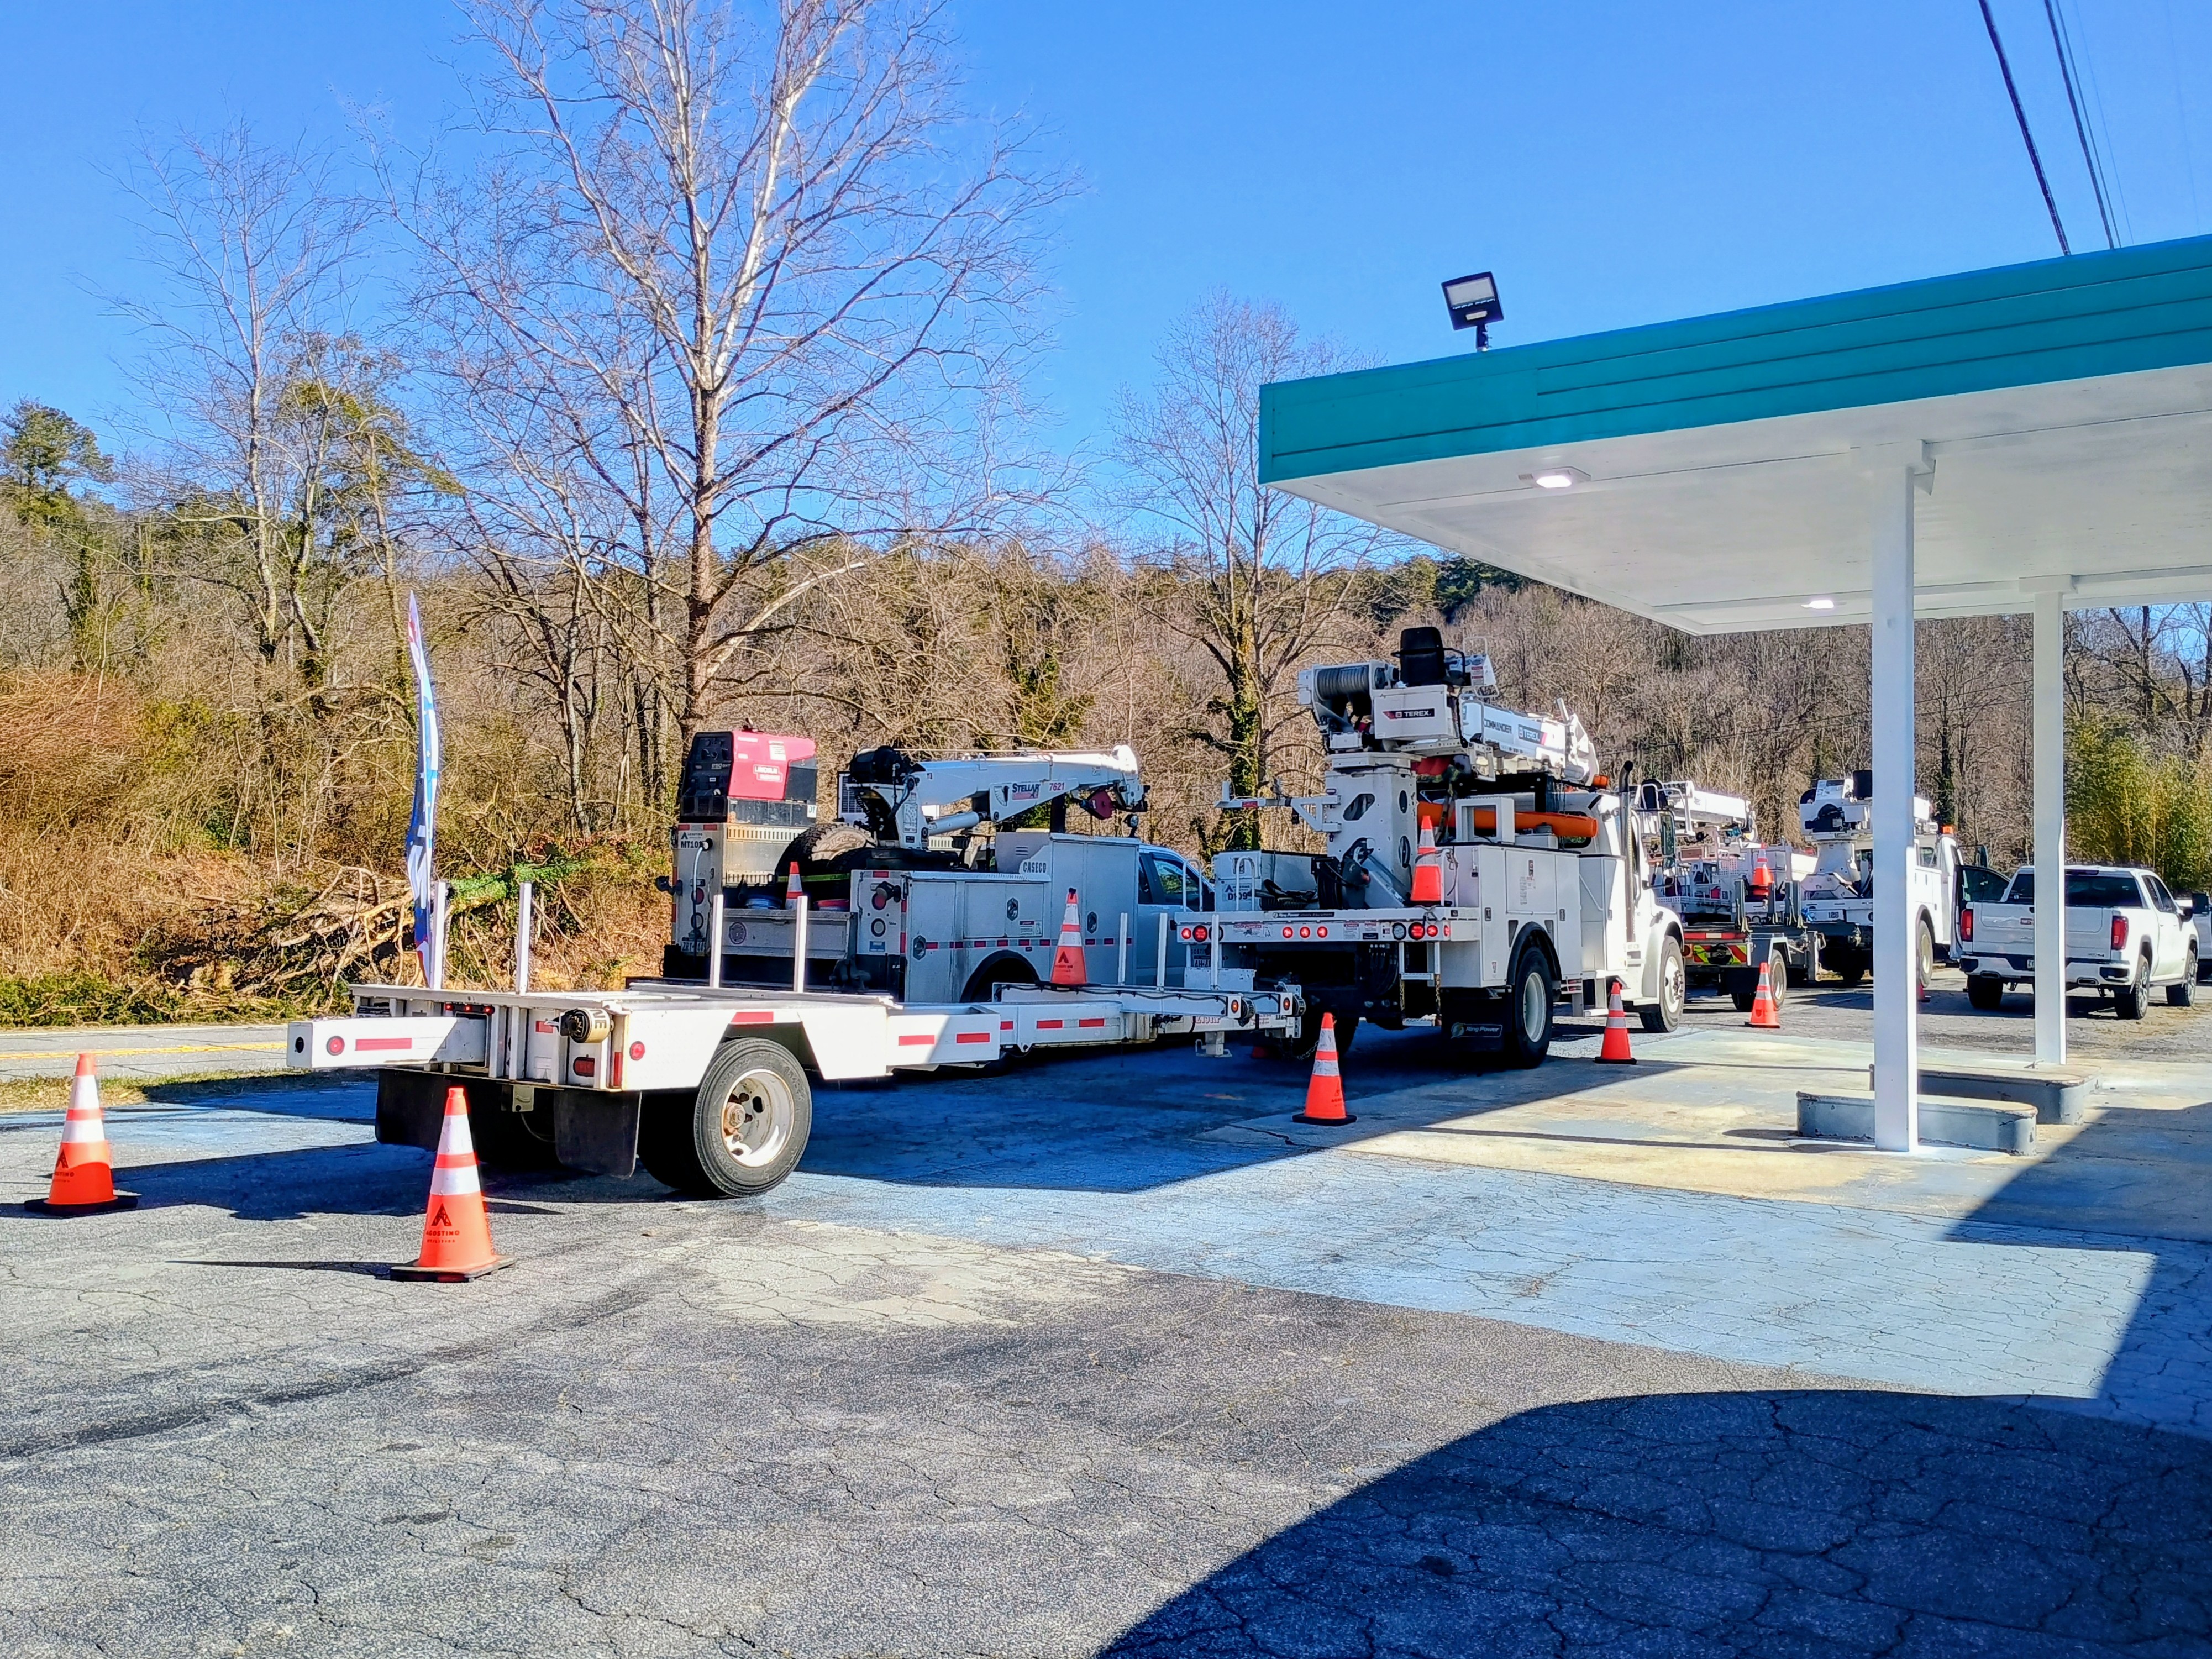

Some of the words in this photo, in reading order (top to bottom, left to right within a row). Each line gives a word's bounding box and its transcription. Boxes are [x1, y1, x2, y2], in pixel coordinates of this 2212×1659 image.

[1012, 783, 1041, 793] STELLAR
[1049, 782, 1065, 791] 7621
[1023, 862, 1047, 873] CASECO
